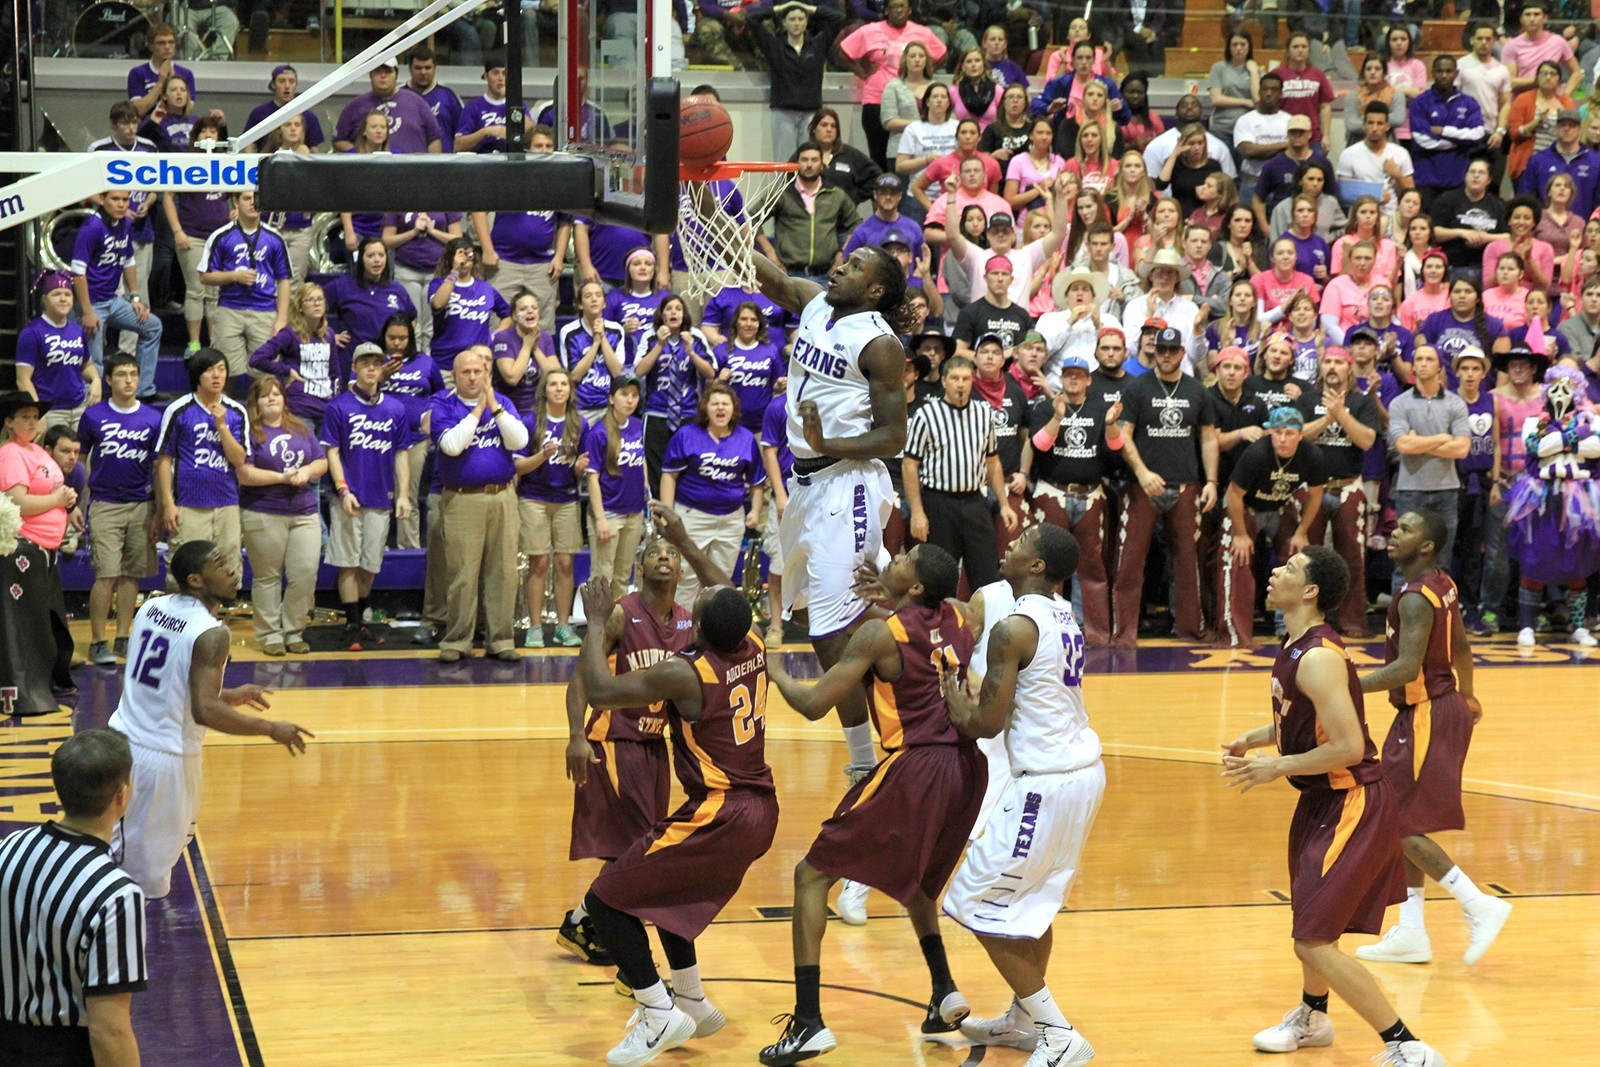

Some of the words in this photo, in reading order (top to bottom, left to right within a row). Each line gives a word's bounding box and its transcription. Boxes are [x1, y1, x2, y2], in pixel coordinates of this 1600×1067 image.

[481, 112, 506, 127] Fo
[445, 304, 489, 324] Play
[622, 303, 656, 318] Fou
[45, 335, 84, 351] Foul
[728, 356, 771, 372] Foul
[793, 336, 848, 379] EXANS
[390, 370, 422, 380] oul
[657, 376, 689, 397] Py
[101, 423, 150, 441] Foul
[349, 414, 393, 432] Foul
[475, 417, 497, 434] oul
[193, 422, 222, 445] Fou
[349, 432, 392, 454] Play
[99, 441, 149, 463] Play
[549, 451, 576, 467] lay
[617, 452, 644, 467] Pla
[700, 452, 739, 467] Foul
[853, 484, 868, 553] TEXANS
[131, 629, 169, 689] 12
[725, 652, 766, 686] ADDERLEY
[1061, 633, 1085, 687] 32
[729, 671, 767, 746] 24
[1012, 791, 1042, 859] TEXANS
